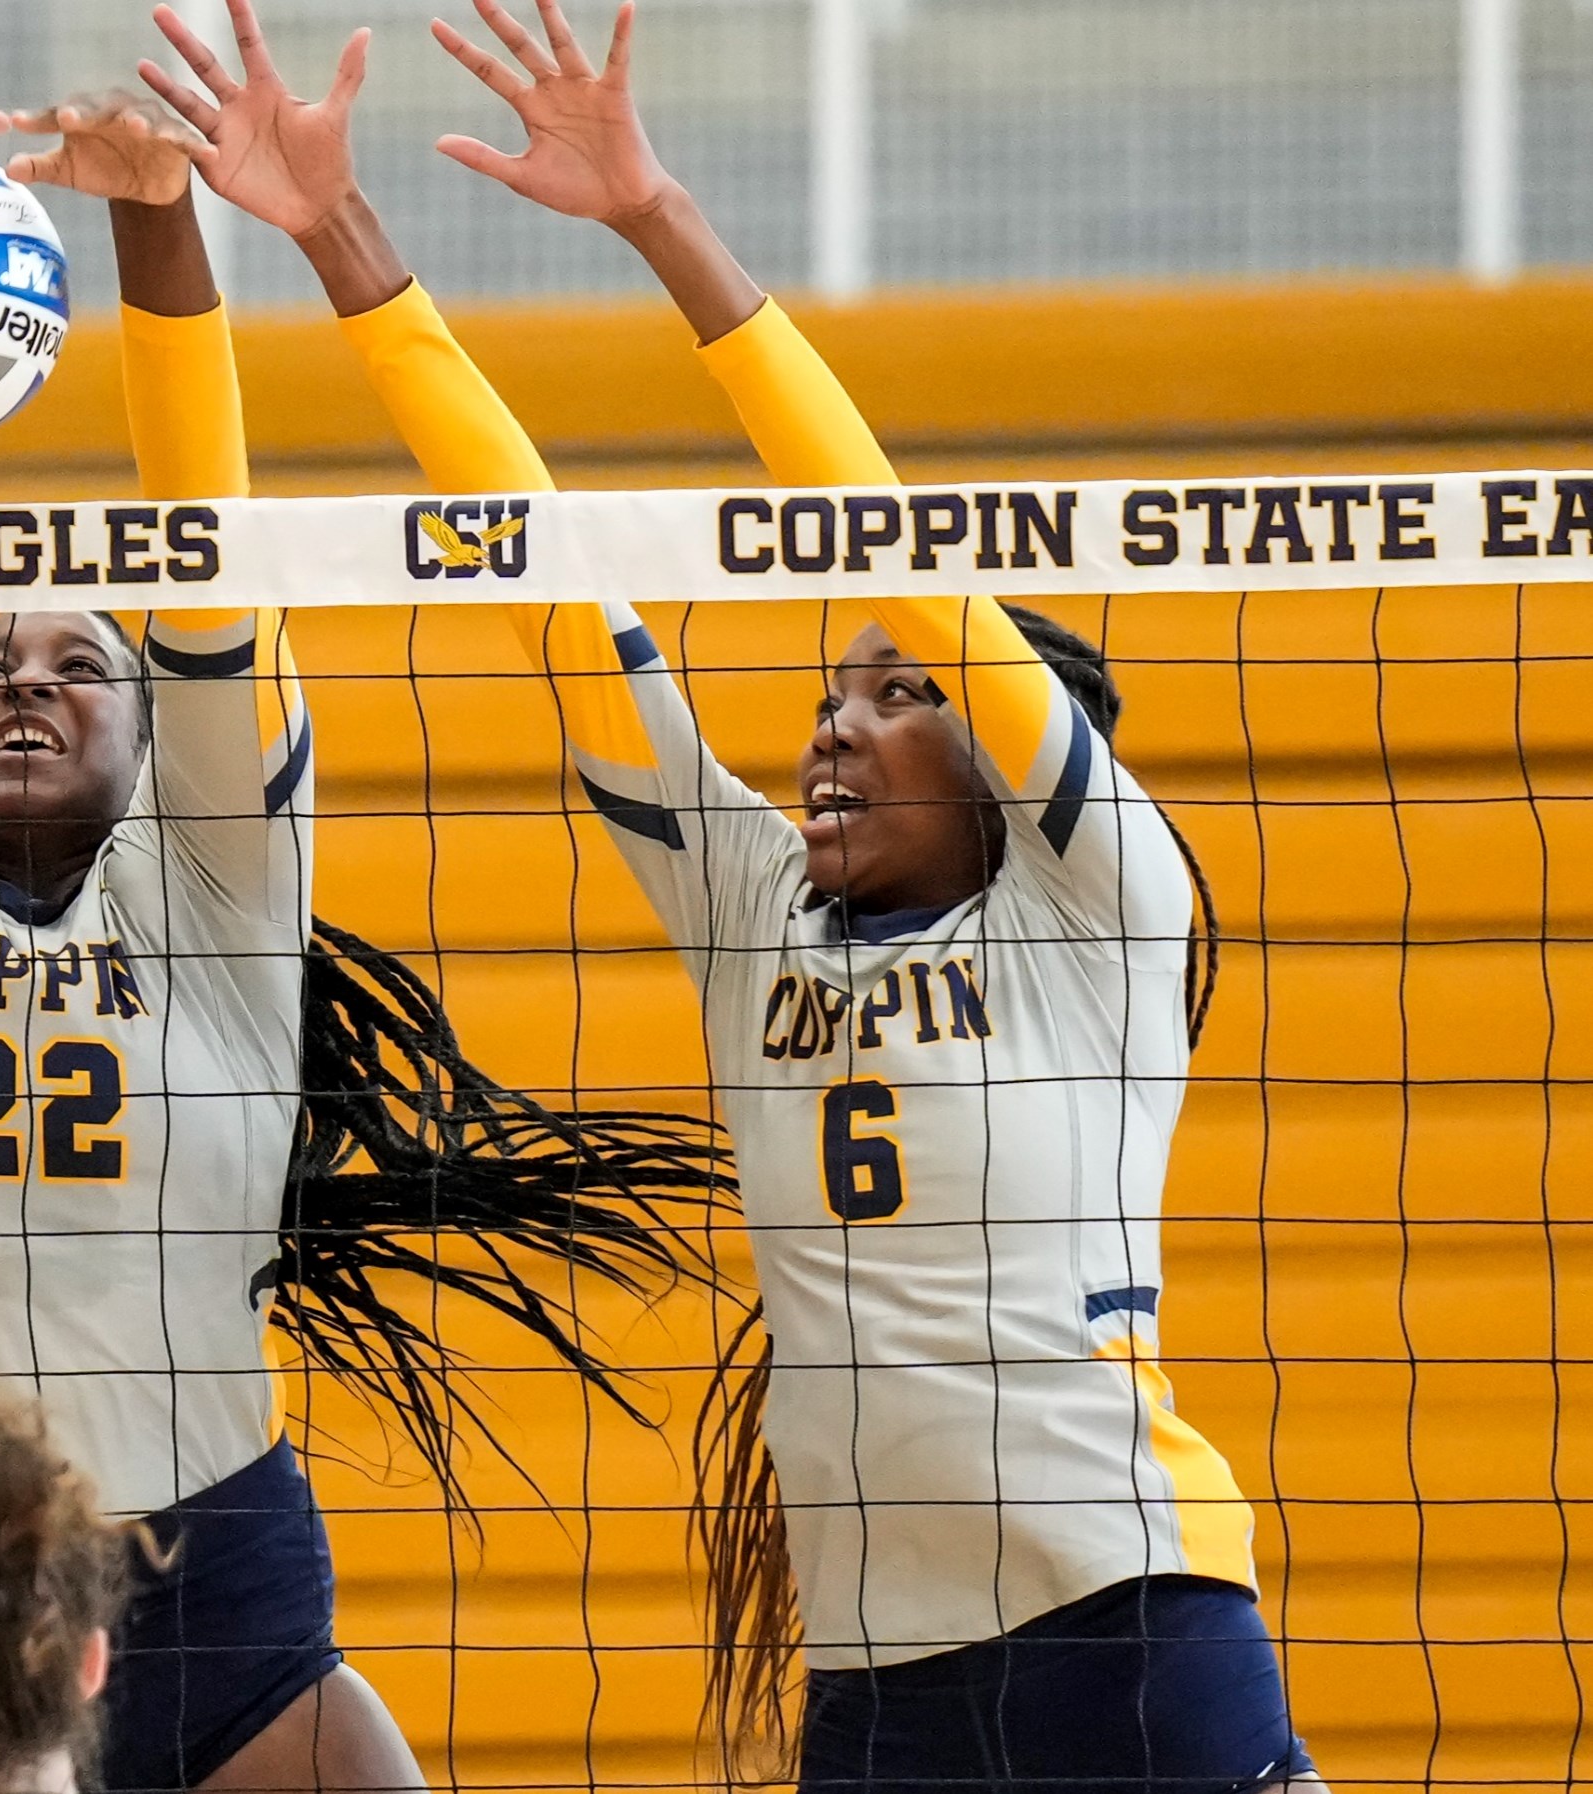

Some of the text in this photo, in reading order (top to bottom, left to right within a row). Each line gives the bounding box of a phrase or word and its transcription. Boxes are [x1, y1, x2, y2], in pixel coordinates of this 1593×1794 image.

[404, 499, 530, 579] CSU
[718, 490, 1078, 574] COPPIN
[1121, 482, 1437, 566] STATE
[762, 957, 993, 1061] COPPIN
[816, 1074, 909, 1225] 6
